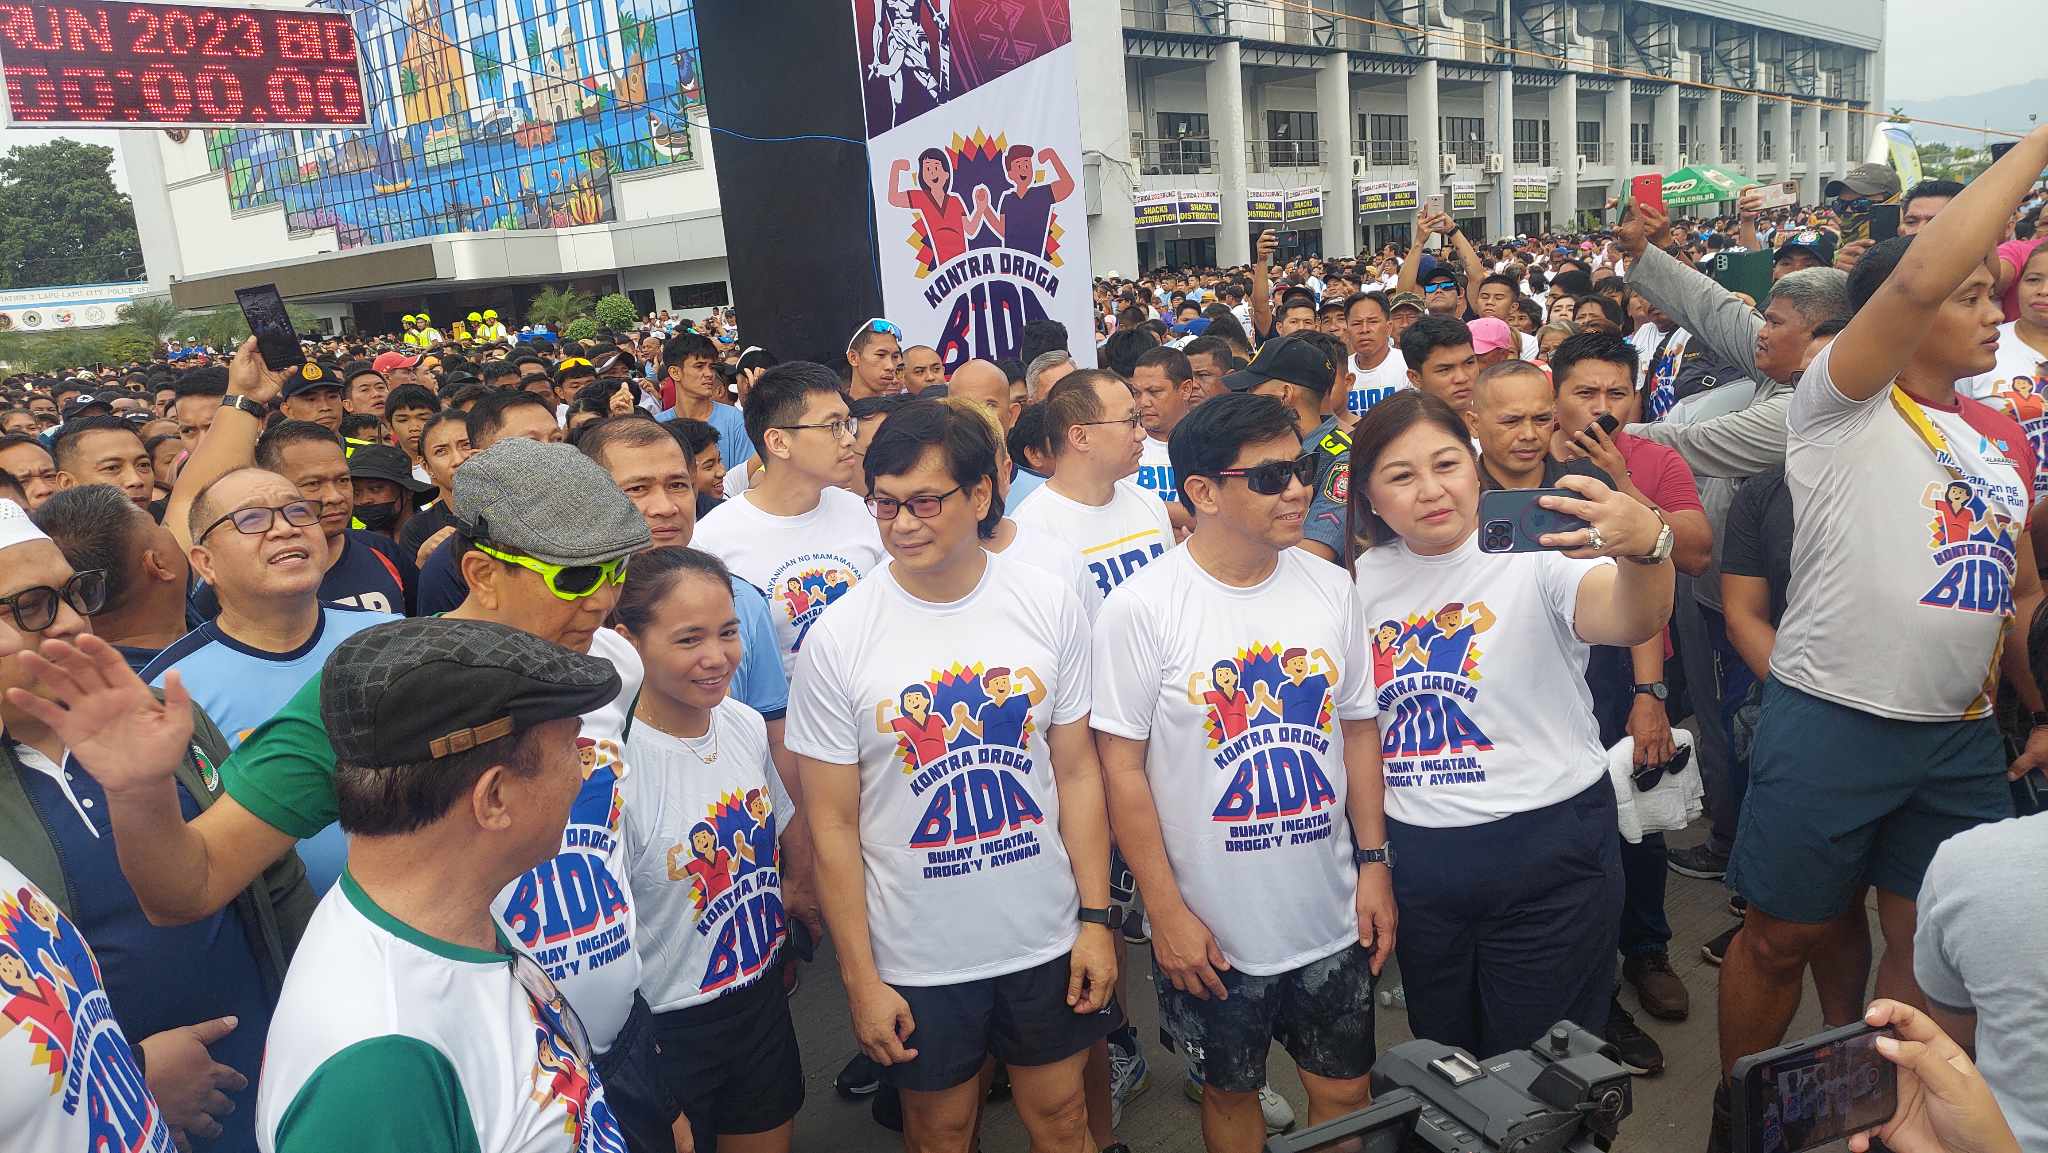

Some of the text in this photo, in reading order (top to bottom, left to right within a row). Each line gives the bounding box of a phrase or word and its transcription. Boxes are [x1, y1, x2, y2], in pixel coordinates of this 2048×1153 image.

[128, 9, 265, 57] 2023
[923, 252, 1060, 310] KONTRA DROGA
[2007, 495, 2024, 508] Run
[766, 558, 797, 600] BAYANIHAN
[812, 553, 863, 581] MAMAMAYAN
[1421, 675, 1479, 703] DROGA
[1213, 727, 1330, 770] KONTRA DROGA
[1382, 693, 1496, 759] BIDA
[909, 748, 1034, 798] KONTRA DROGA
[1211, 746, 1337, 821] BIDA
[1429, 770, 1487, 786] AYAWAN
[908, 768, 1046, 849] BIDA
[1229, 822, 1274, 838] BUHAY
[922, 842, 1041, 880] DROGA'Y AYAWAN
[927, 846, 973, 865] BUHAY
[1225, 835, 1283, 852] DROGA'Y
[503, 852, 630, 949] BIDA
[695, 877, 754, 937] KONTRA
[589, 936, 631, 971] AYAWAN
[62, 1010, 93, 1116] KONTRA
